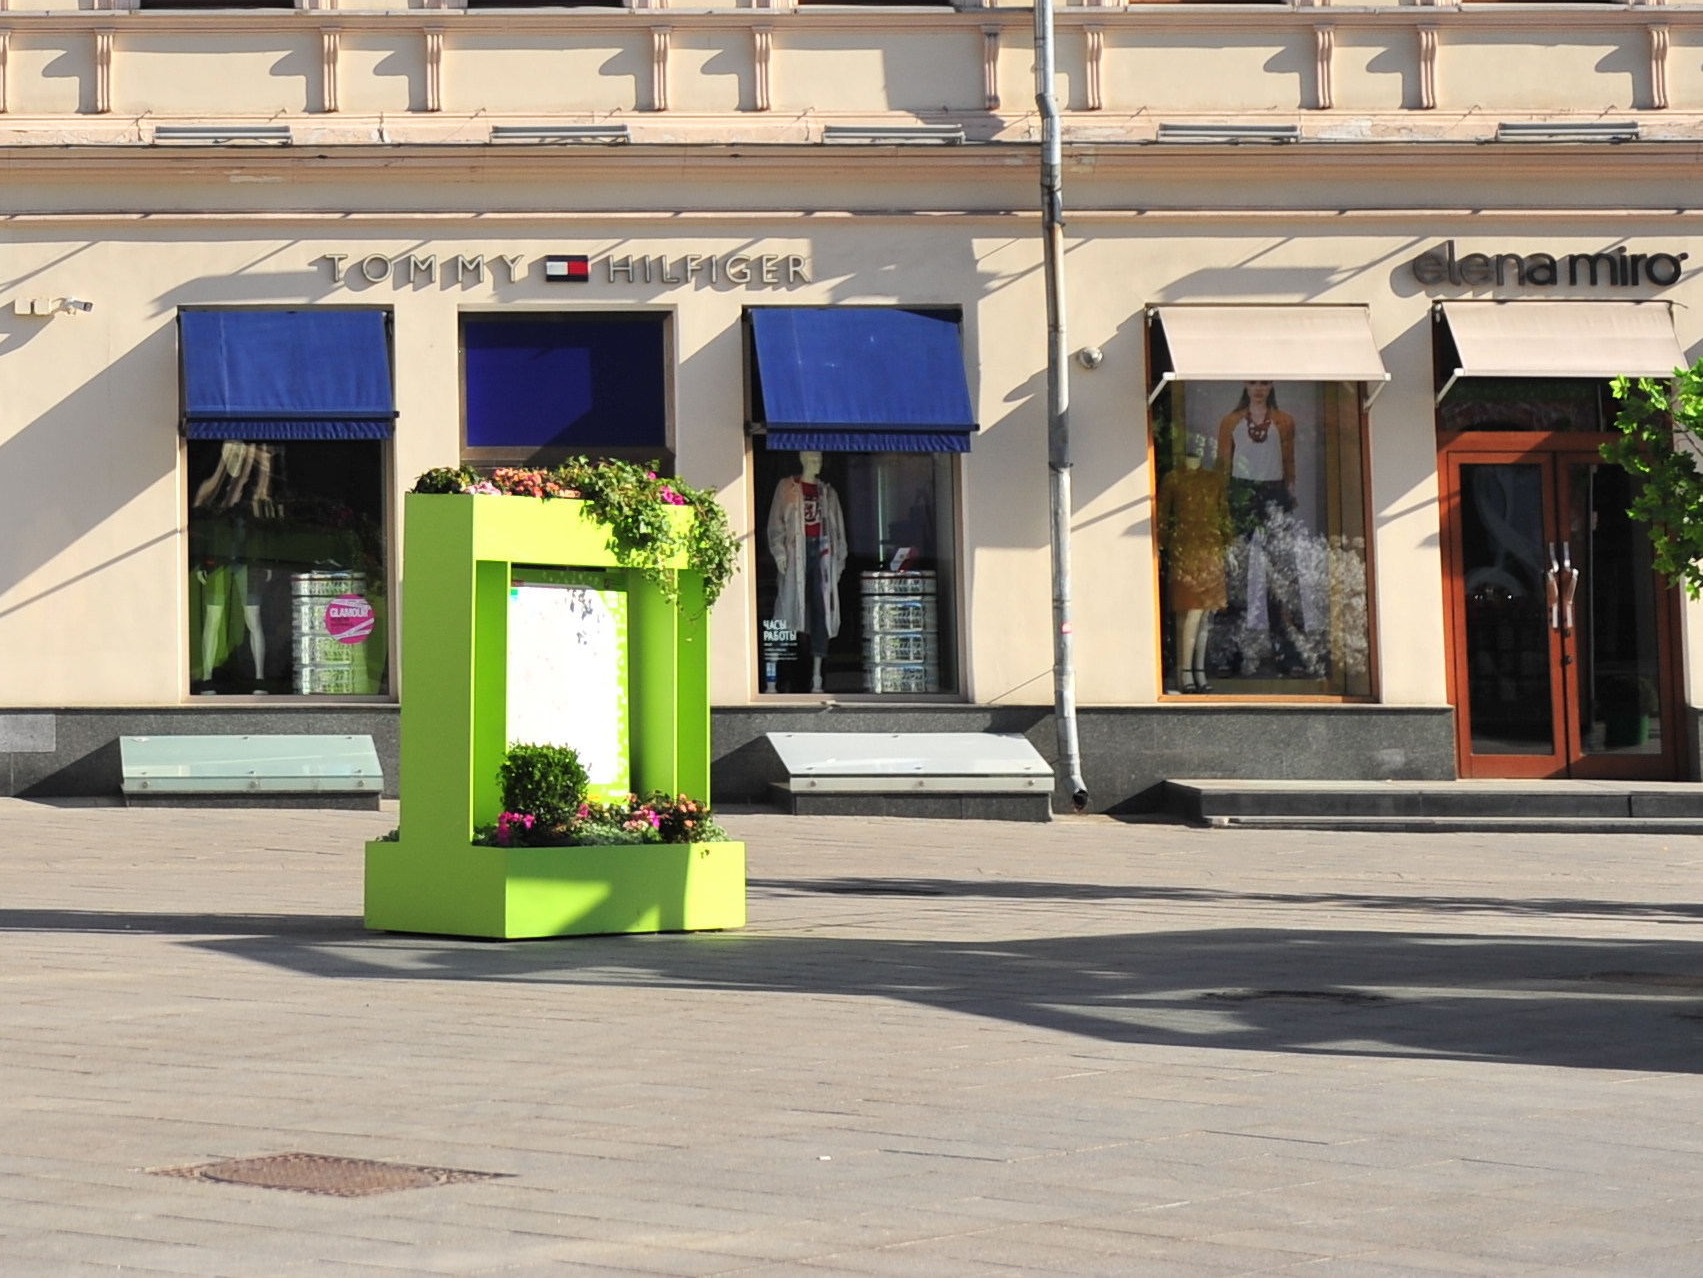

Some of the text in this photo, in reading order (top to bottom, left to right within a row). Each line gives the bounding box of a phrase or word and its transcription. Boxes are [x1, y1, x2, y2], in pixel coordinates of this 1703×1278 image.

[325, 254, 811, 284] TOMMY HILFIGER
[1413, 239, 1558, 287] elena
[763, 620, 787, 630] ЧАСЫ
[763, 630, 797, 642] РАБОТЫ
